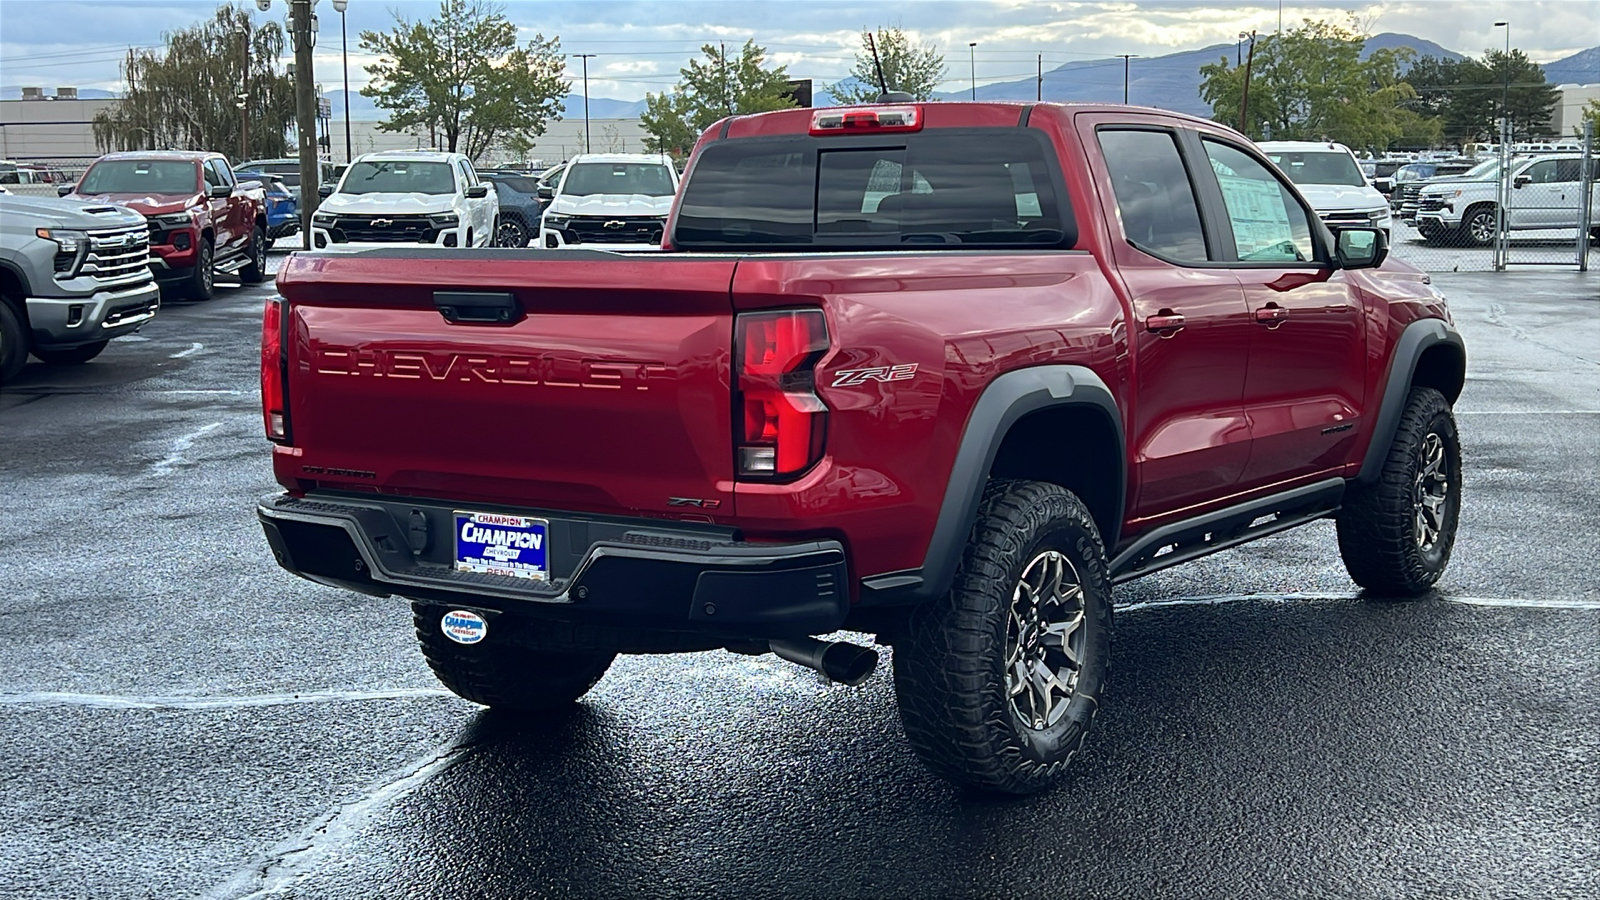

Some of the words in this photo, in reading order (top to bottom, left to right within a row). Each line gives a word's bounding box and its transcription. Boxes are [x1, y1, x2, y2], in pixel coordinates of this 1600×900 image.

[317, 350, 666, 391] CHEVROLET
[831, 363, 919, 387] ZR2
[666, 496, 720, 508] ZR2
[478, 515, 521, 526] CHAMPION
[461, 522, 542, 550] CHAMPION
[486, 548, 517, 557] CHEVROLET
[487, 568, 515, 577] RENO
